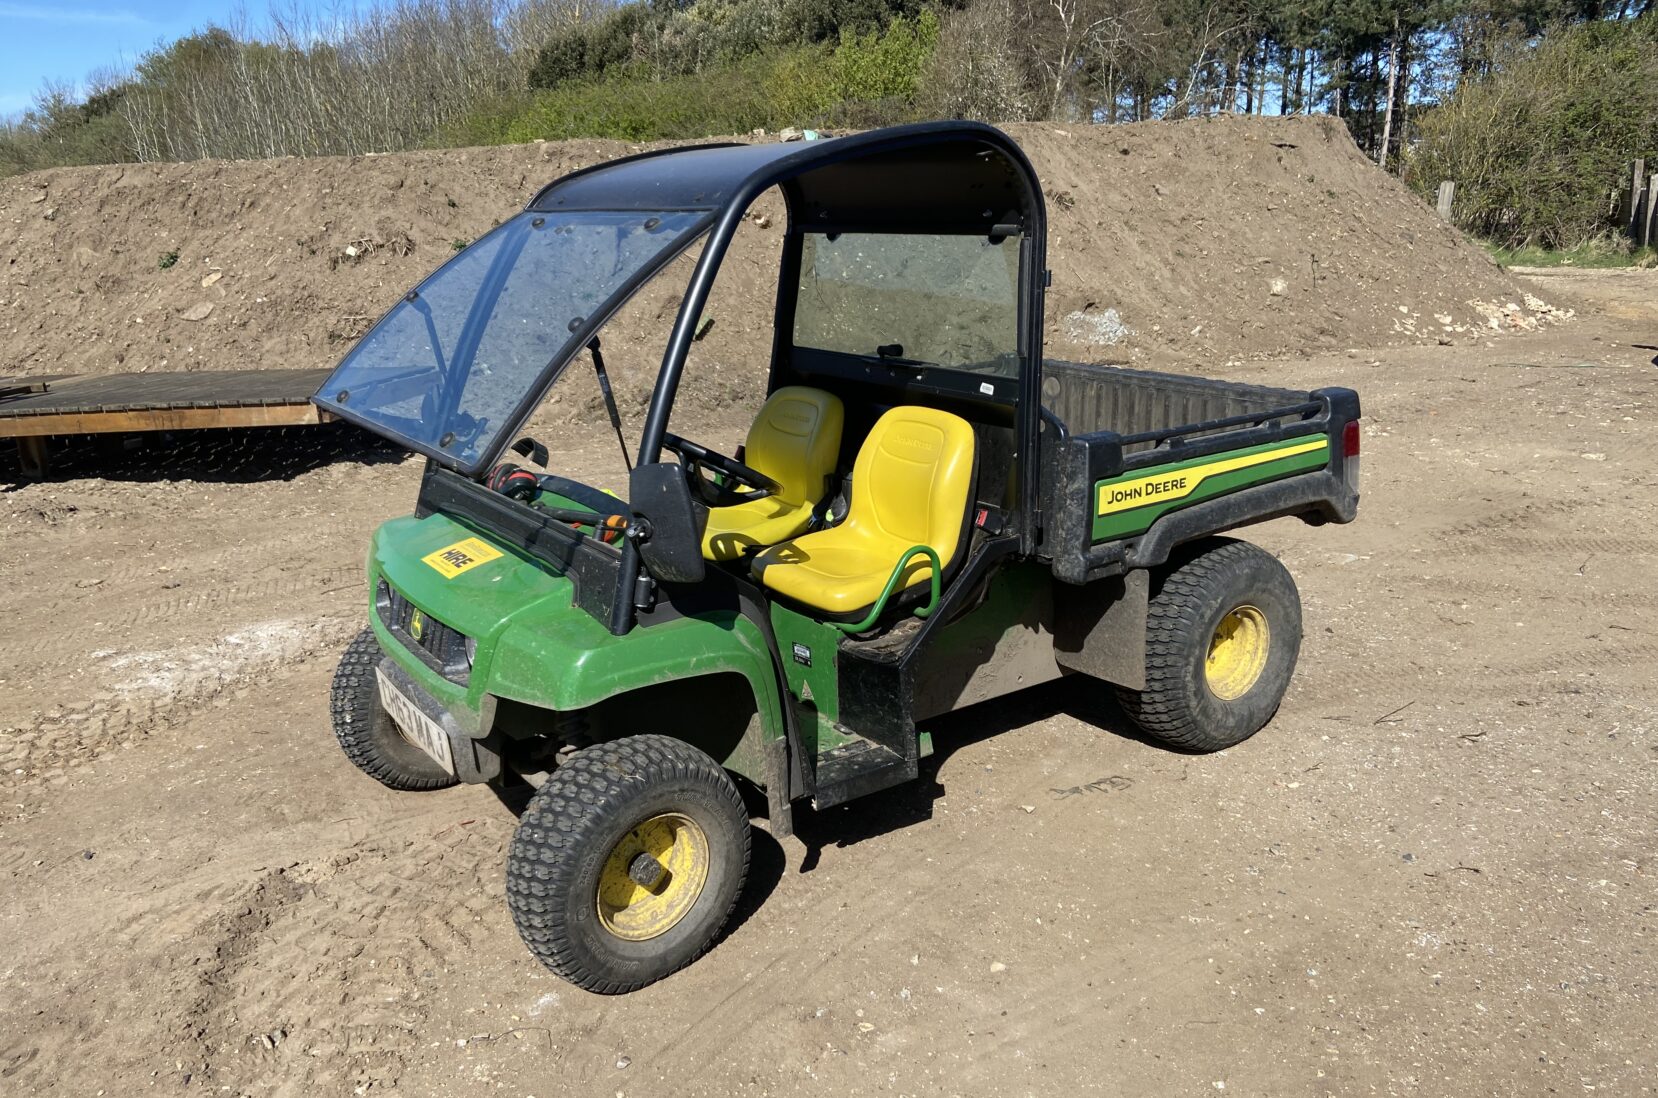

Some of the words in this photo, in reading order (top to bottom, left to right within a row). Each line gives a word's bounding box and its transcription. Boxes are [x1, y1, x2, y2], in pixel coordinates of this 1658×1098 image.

[1107, 487, 1142, 504] JOHN
[1145, 478, 1187, 496] DEERE
[440, 549, 475, 568] HIRE
